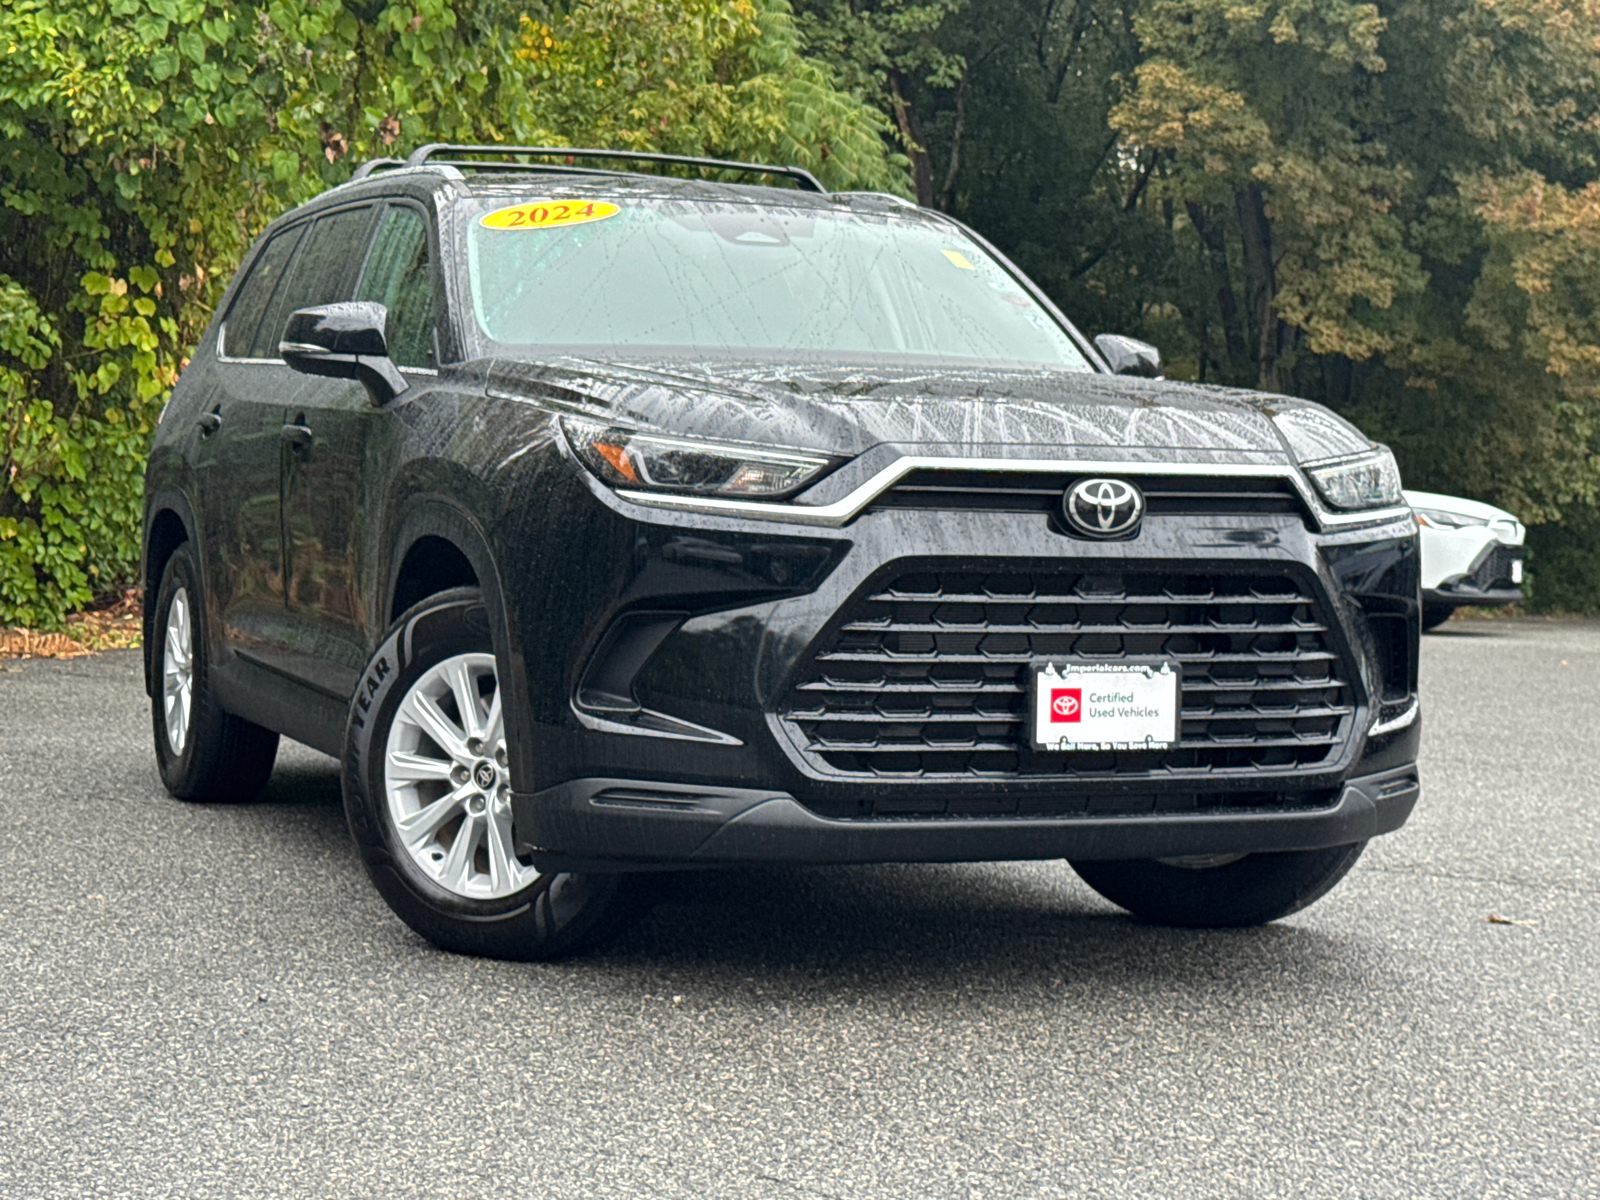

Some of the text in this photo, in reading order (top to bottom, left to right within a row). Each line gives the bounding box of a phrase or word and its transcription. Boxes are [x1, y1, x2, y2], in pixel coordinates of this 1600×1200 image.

[507, 203, 596, 227] 2024
[1089, 692, 1134, 703] Certified
[1089, 706, 1160, 718] Used Vehicles
[1046, 742, 1060, 751] We
[1101, 742, 1111, 751] So
[1112, 742, 1127, 751] You
